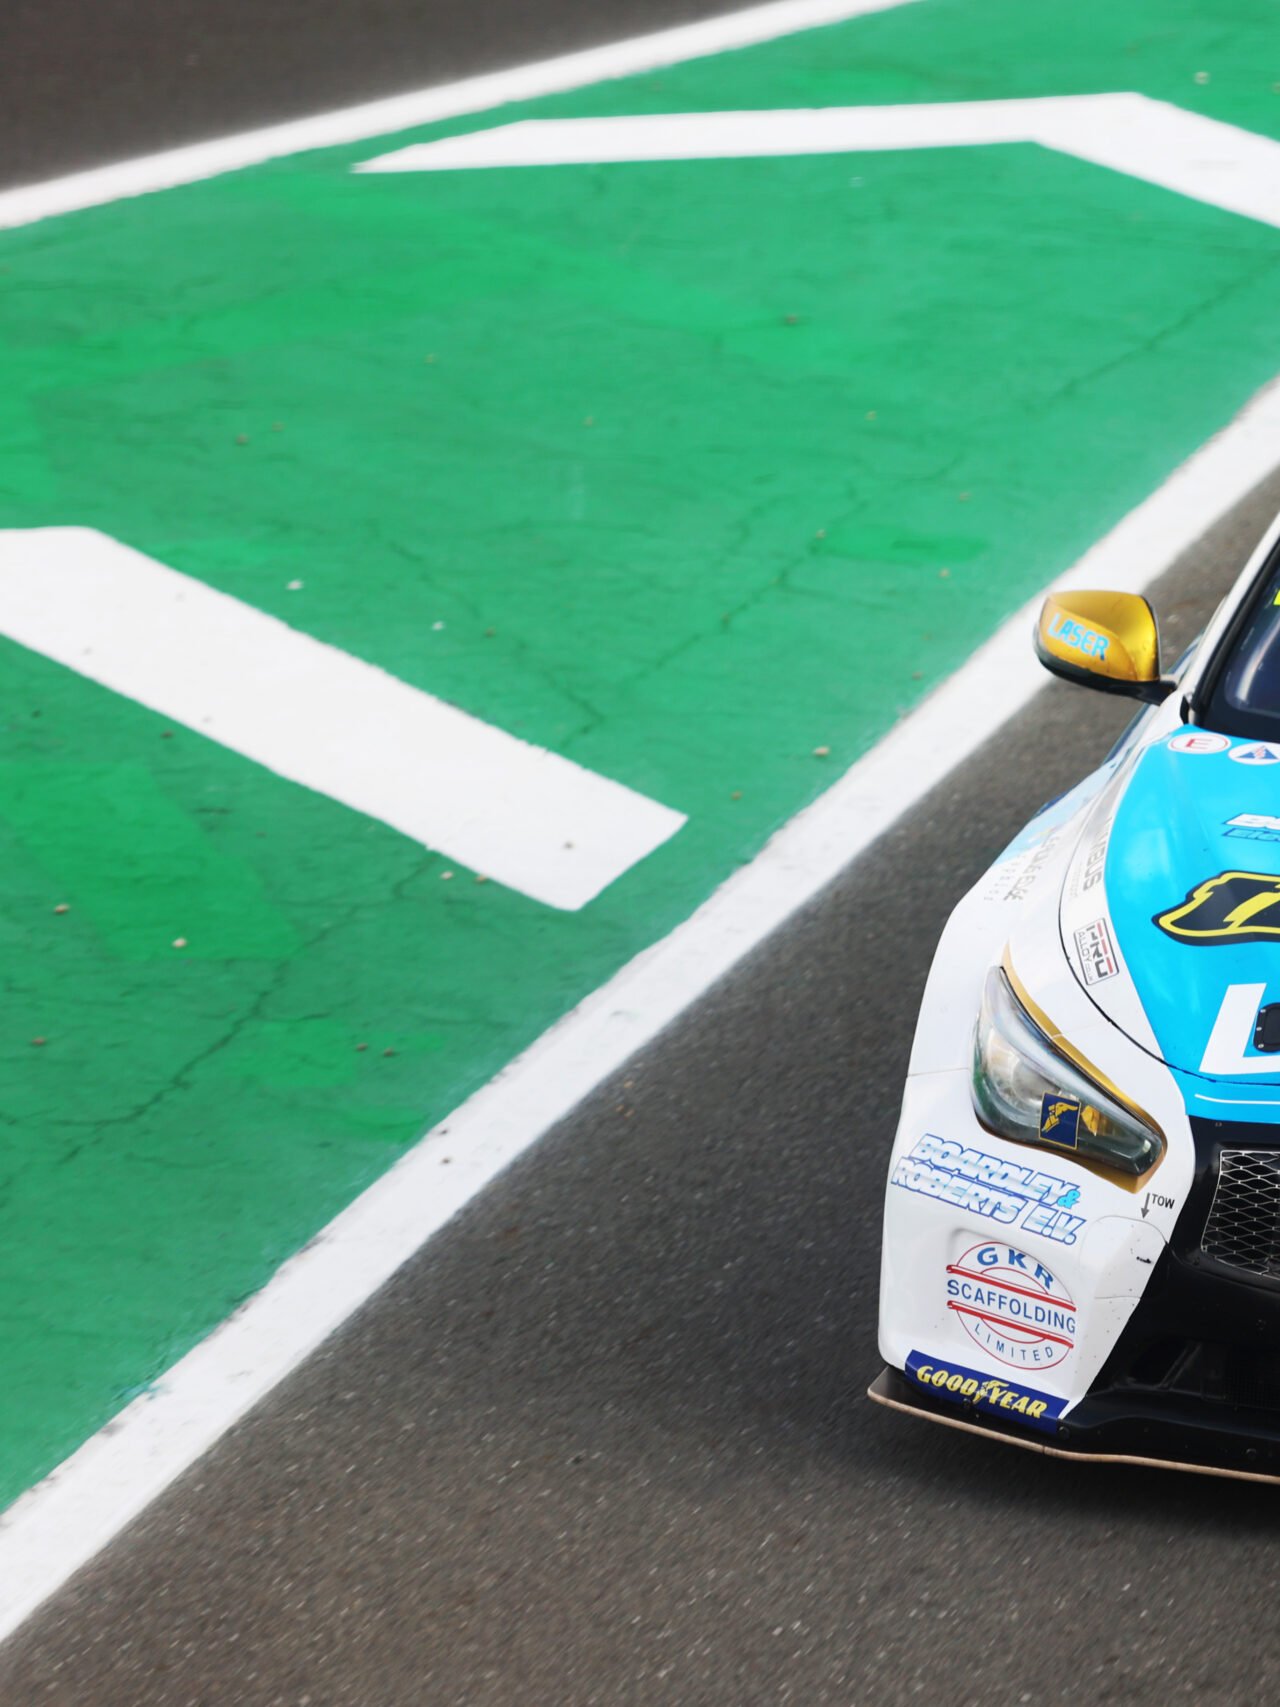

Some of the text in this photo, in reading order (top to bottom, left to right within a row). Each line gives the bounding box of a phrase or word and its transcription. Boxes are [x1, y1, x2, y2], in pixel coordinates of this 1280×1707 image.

[1049, 613, 1110, 661] LASER
[890, 1156, 1087, 1246] ROBERTS E.V.
[1151, 1193, 1176, 1210] TOW
[976, 1246, 1055, 1290] GKR
[946, 1279, 1077, 1334] SCAFFOLDING
[975, 1322, 1054, 1362] LIMITED
[916, 1365, 1048, 1419] GOODYEAR
